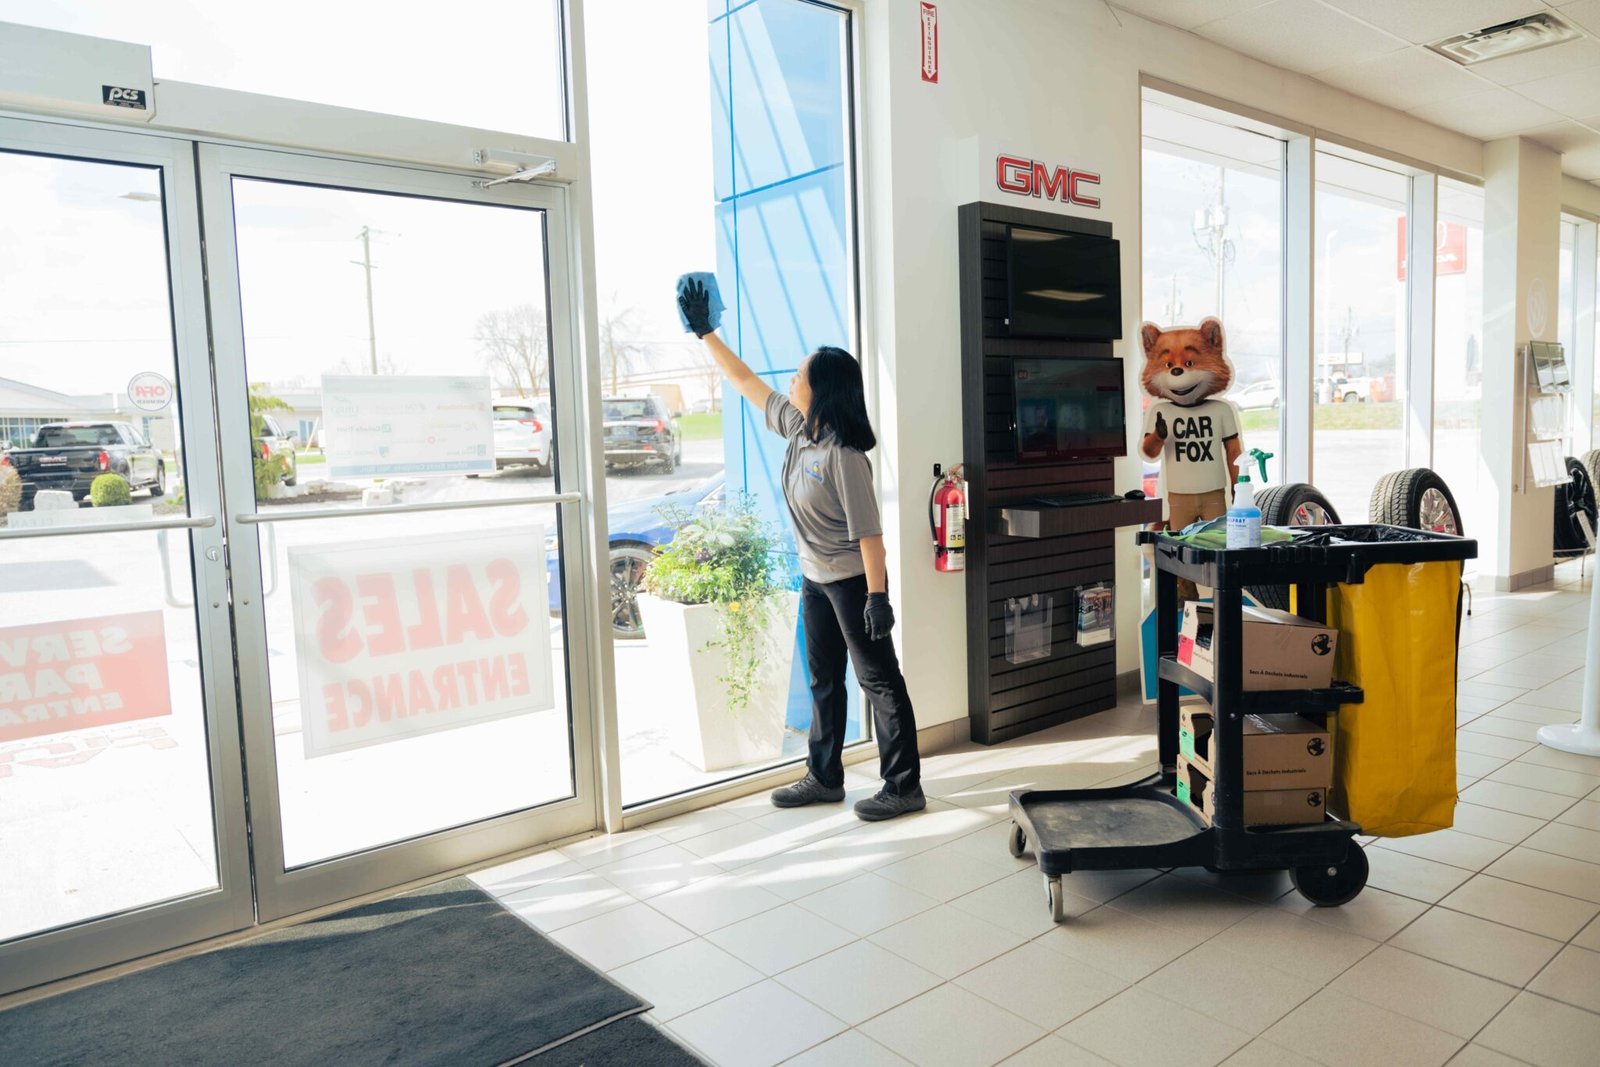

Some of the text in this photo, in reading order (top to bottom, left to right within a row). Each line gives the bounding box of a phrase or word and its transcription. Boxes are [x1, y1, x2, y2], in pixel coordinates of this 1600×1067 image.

[922, 8, 936, 18] FIRE
[108, 87, 139, 101] pcs
[995, 153, 1102, 208] GMC
[1172, 415, 1214, 439] CAR
[1174, 439, 1215, 463] FOX
